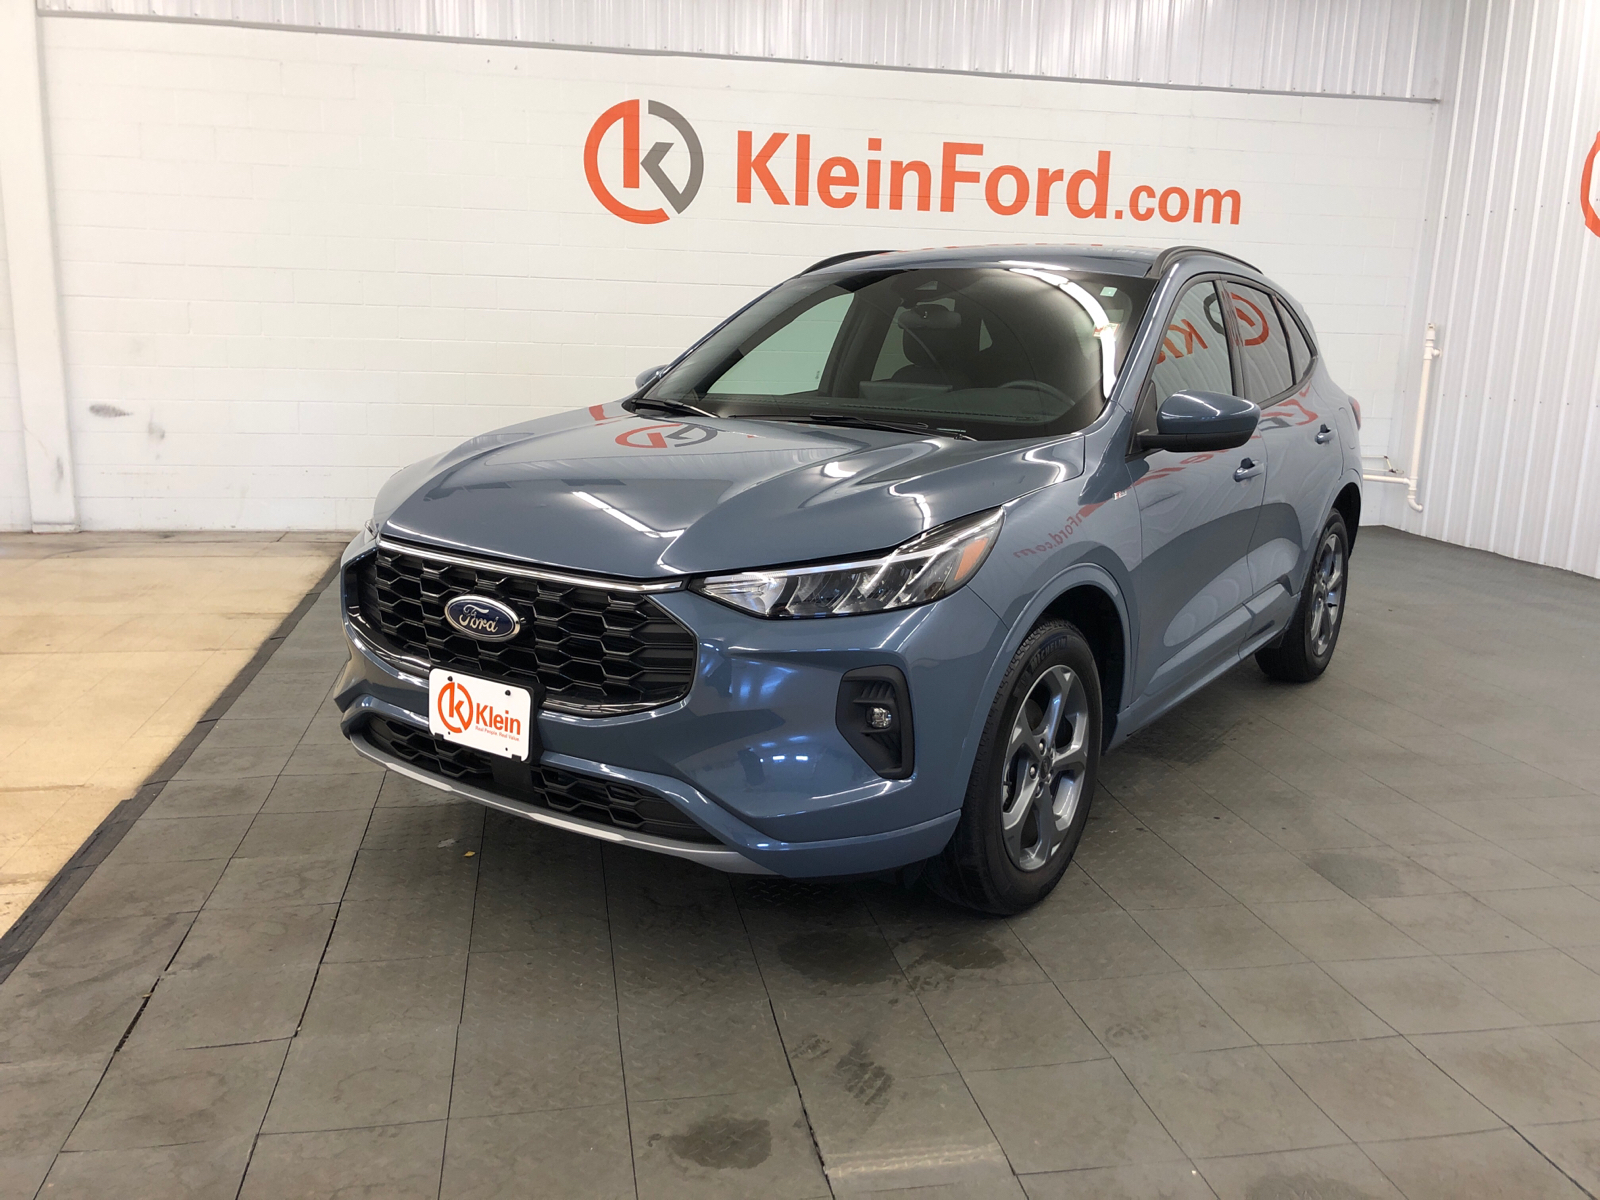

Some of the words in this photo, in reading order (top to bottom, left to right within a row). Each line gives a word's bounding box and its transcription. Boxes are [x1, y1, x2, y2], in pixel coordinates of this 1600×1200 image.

[736, 130, 1241, 225] KleinFord.com
[458, 604, 499, 633] Ford
[476, 702, 521, 736] Klein
